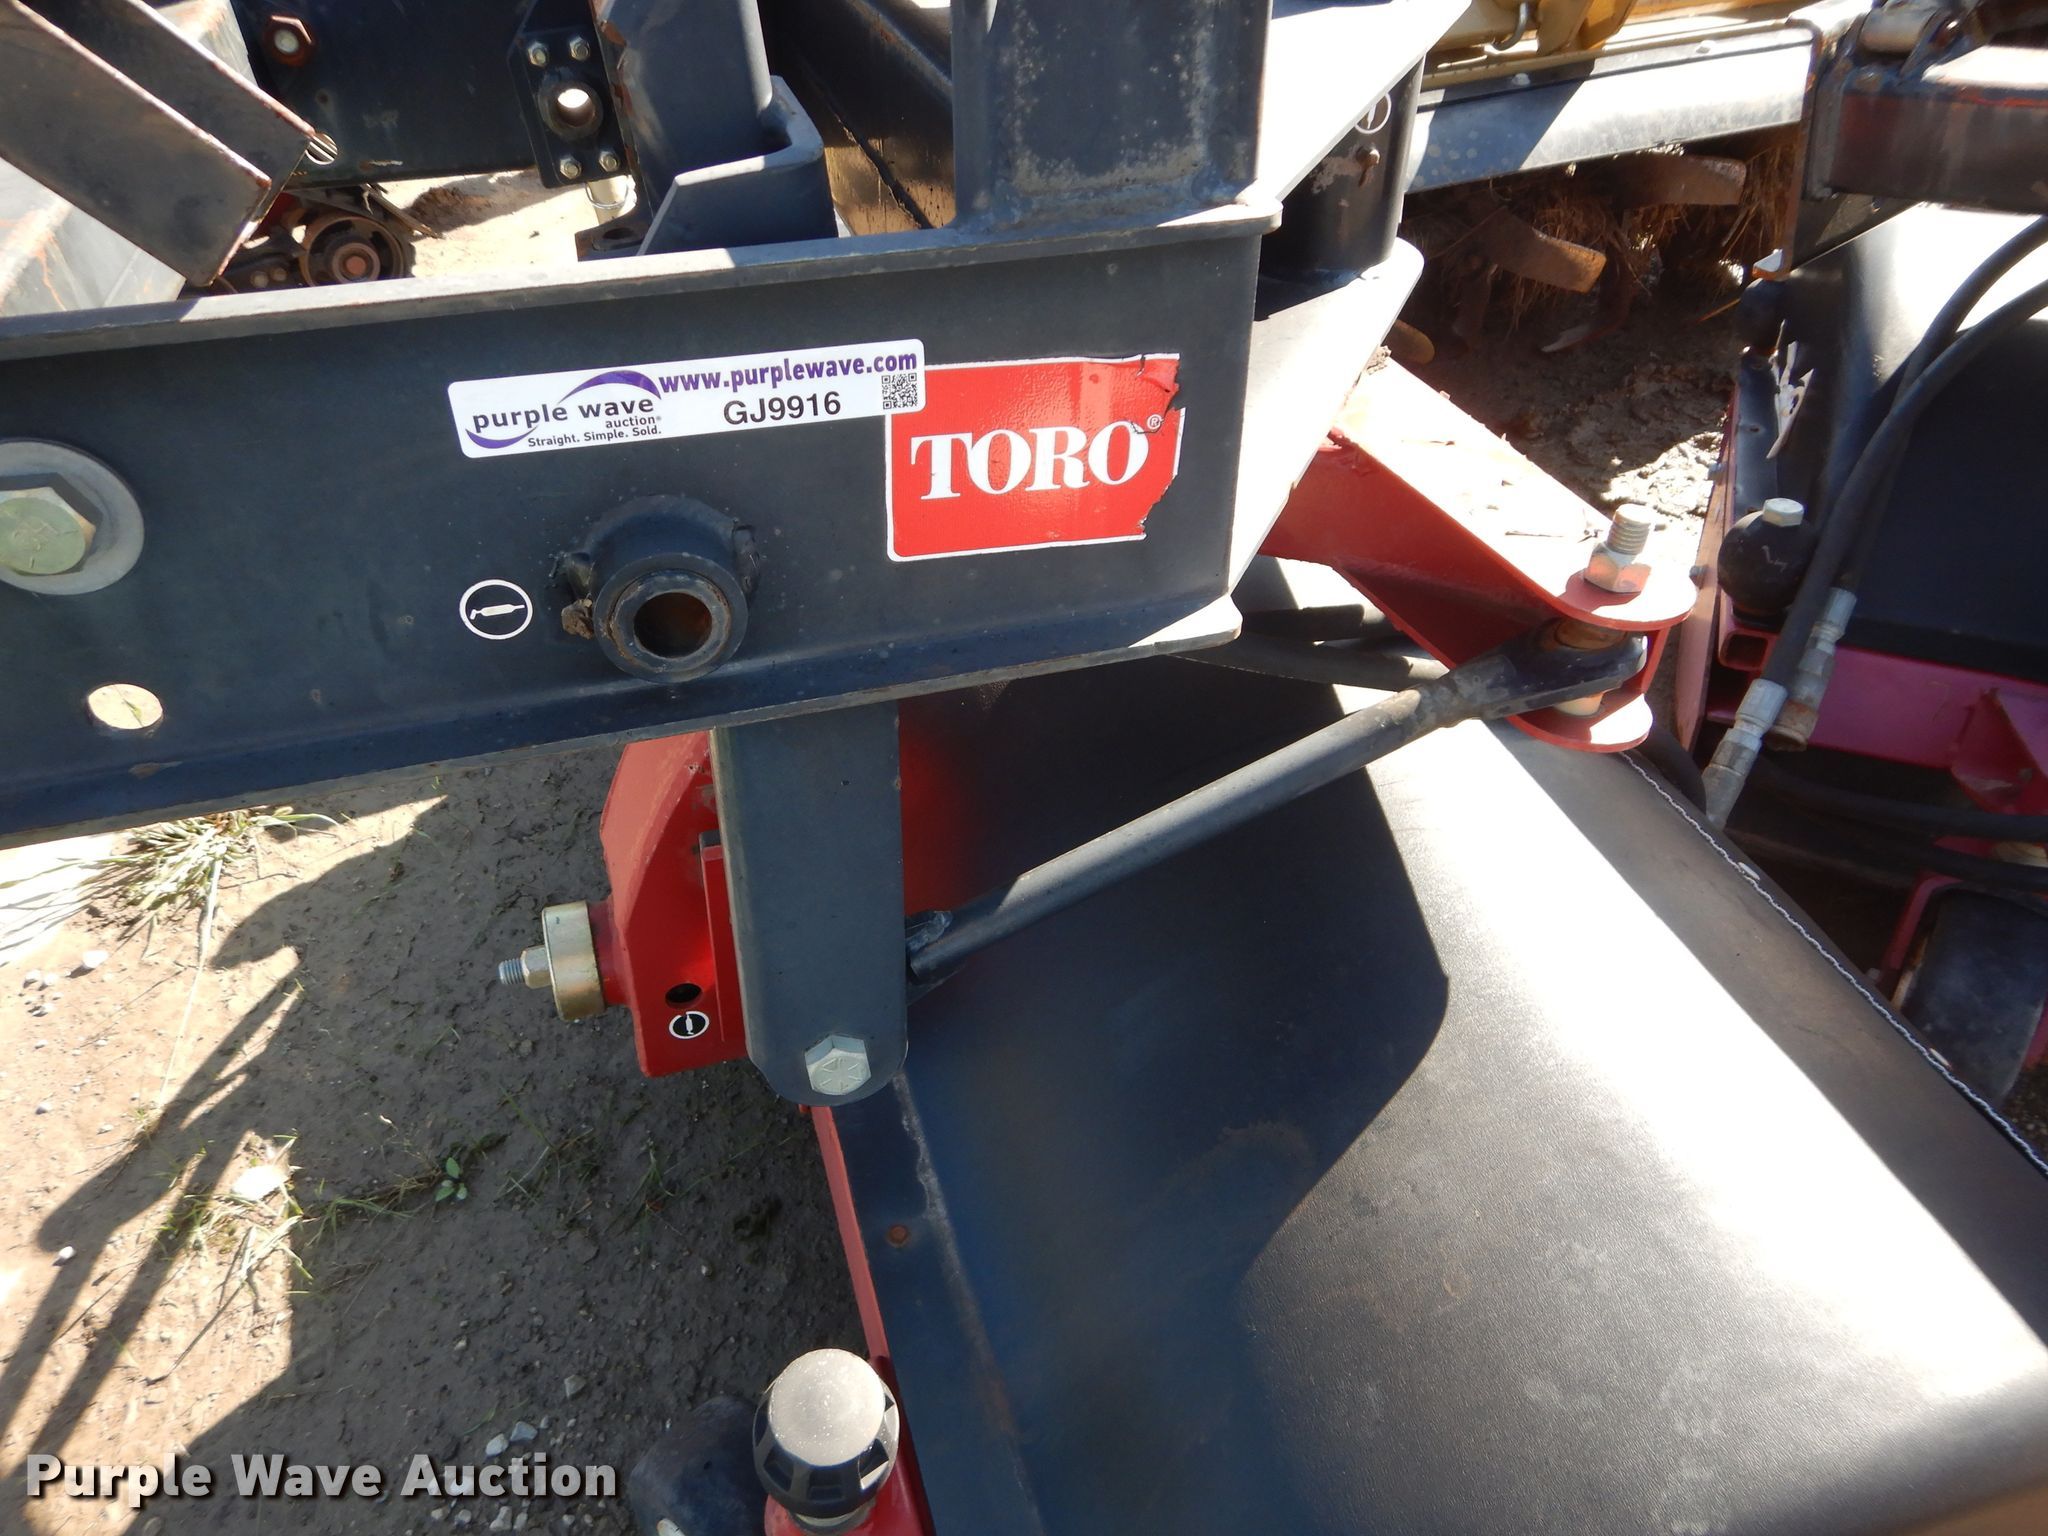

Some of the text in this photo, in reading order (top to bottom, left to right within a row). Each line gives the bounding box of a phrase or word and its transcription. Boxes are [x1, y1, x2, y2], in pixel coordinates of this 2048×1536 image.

[658, 352, 918, 394] www.purplewave.com
[472, 398, 655, 434] purple wave
[605, 415, 656, 430] auction
[723, 391, 842, 426] GJ9916
[527, 424, 662, 448] Straight. Simple. Sold.
[910, 420, 1150, 501] TORO
